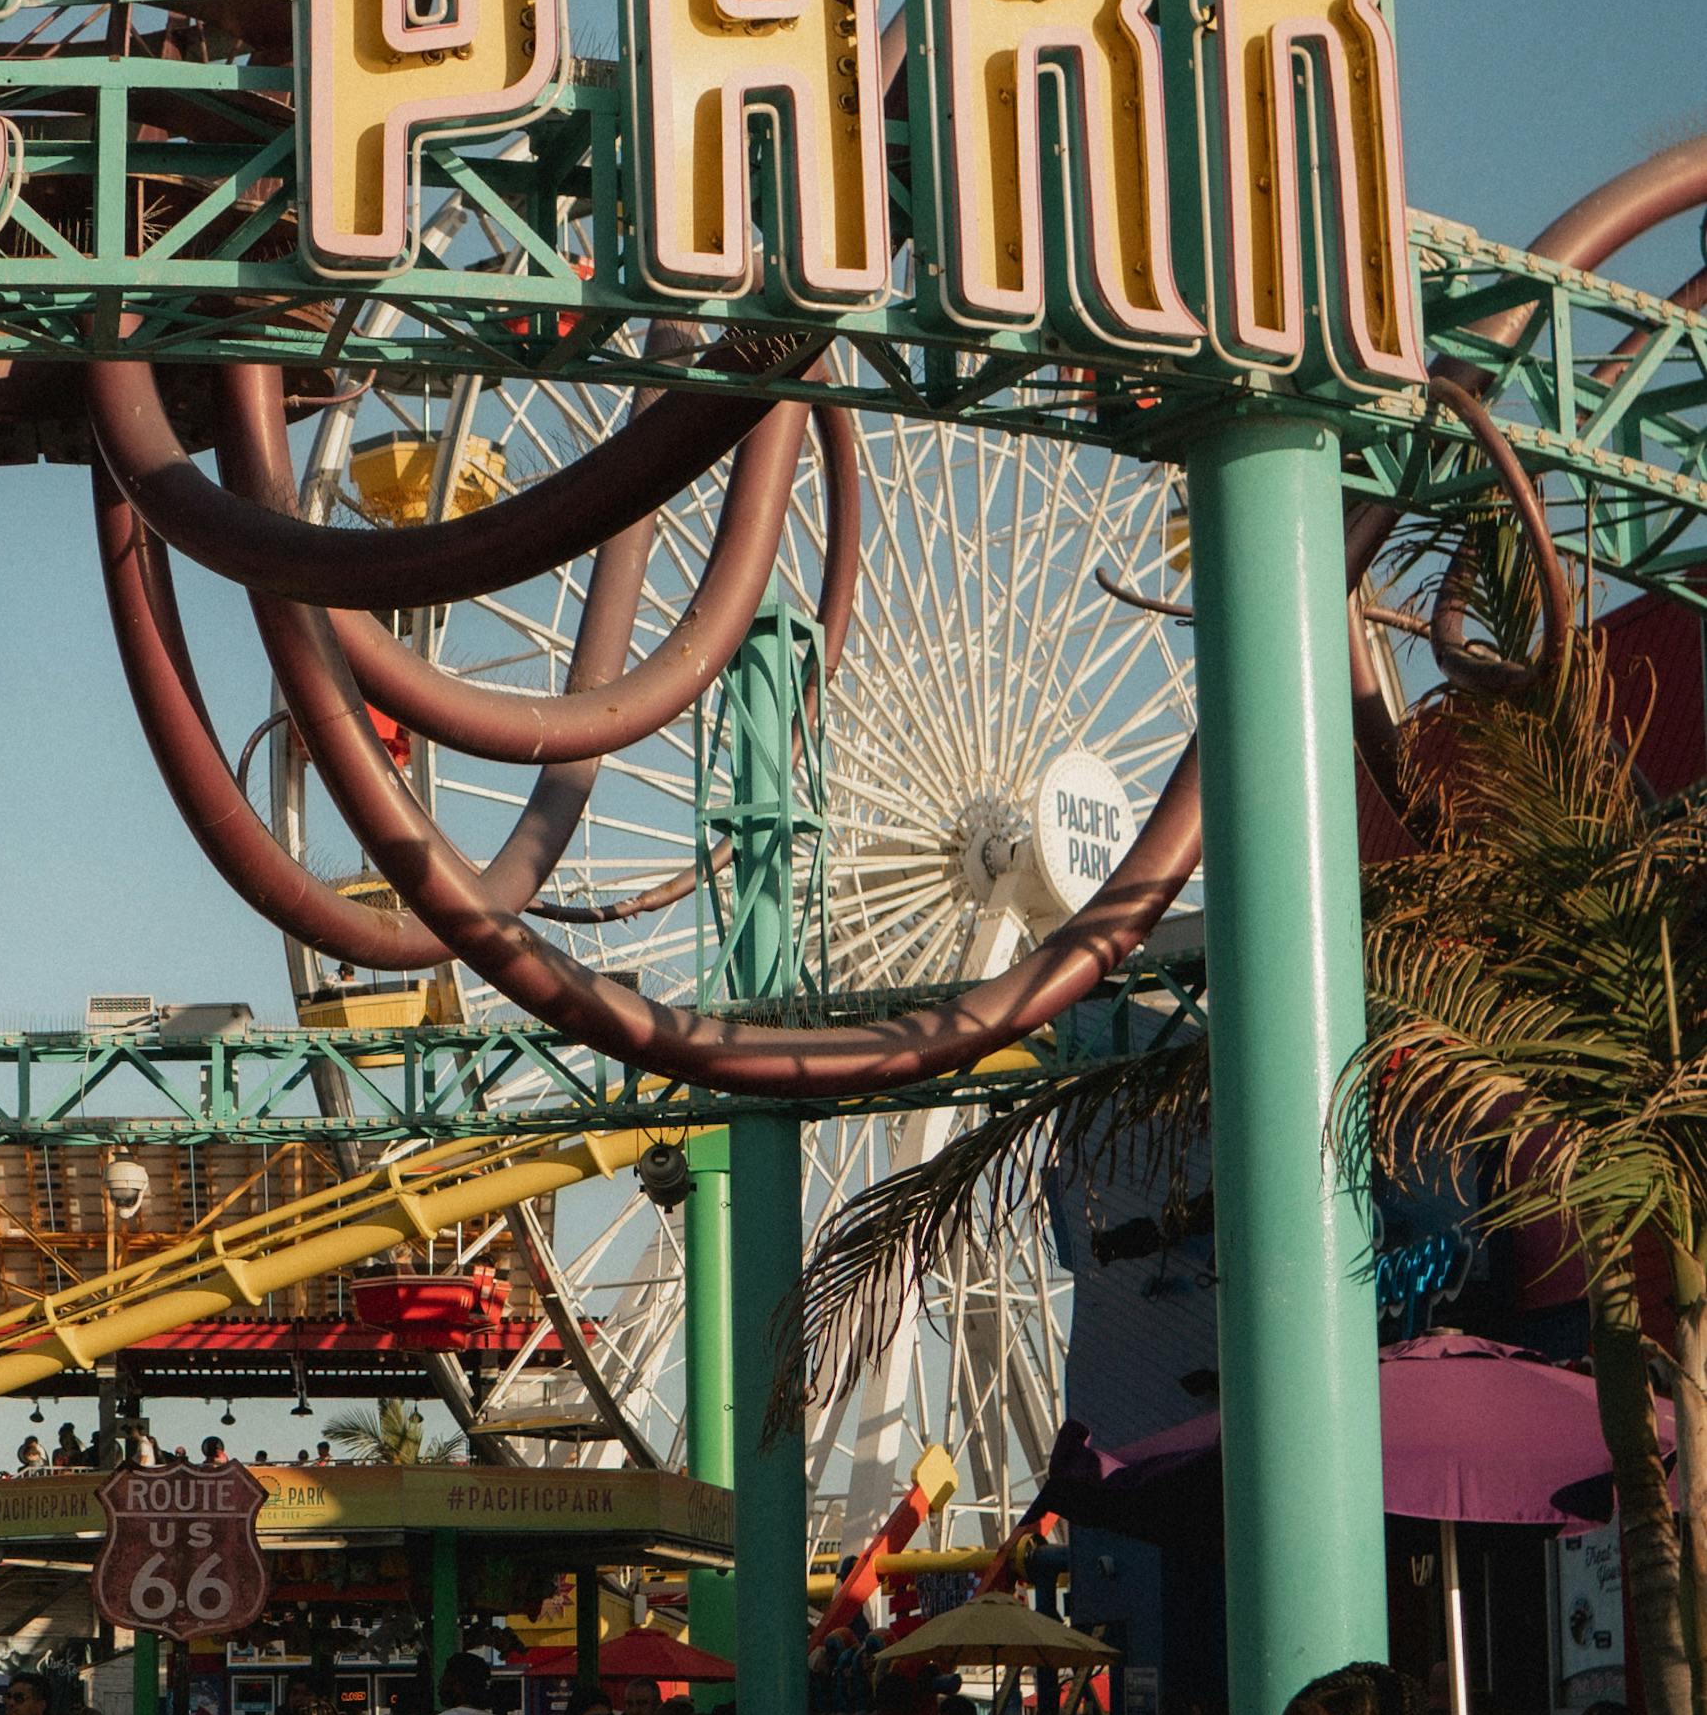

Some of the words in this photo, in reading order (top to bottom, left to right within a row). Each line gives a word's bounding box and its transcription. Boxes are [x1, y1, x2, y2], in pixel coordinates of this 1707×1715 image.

[1056, 790, 1121, 843] PACIFIC
[1069, 837, 1112, 882] PARK
[126, 1478, 236, 1511] ROUTE
[288, 1486, 325, 1506] PARK
[446, 1485, 614, 1513] #PACIFICPARK
[129, 1552, 233, 1620] 66
